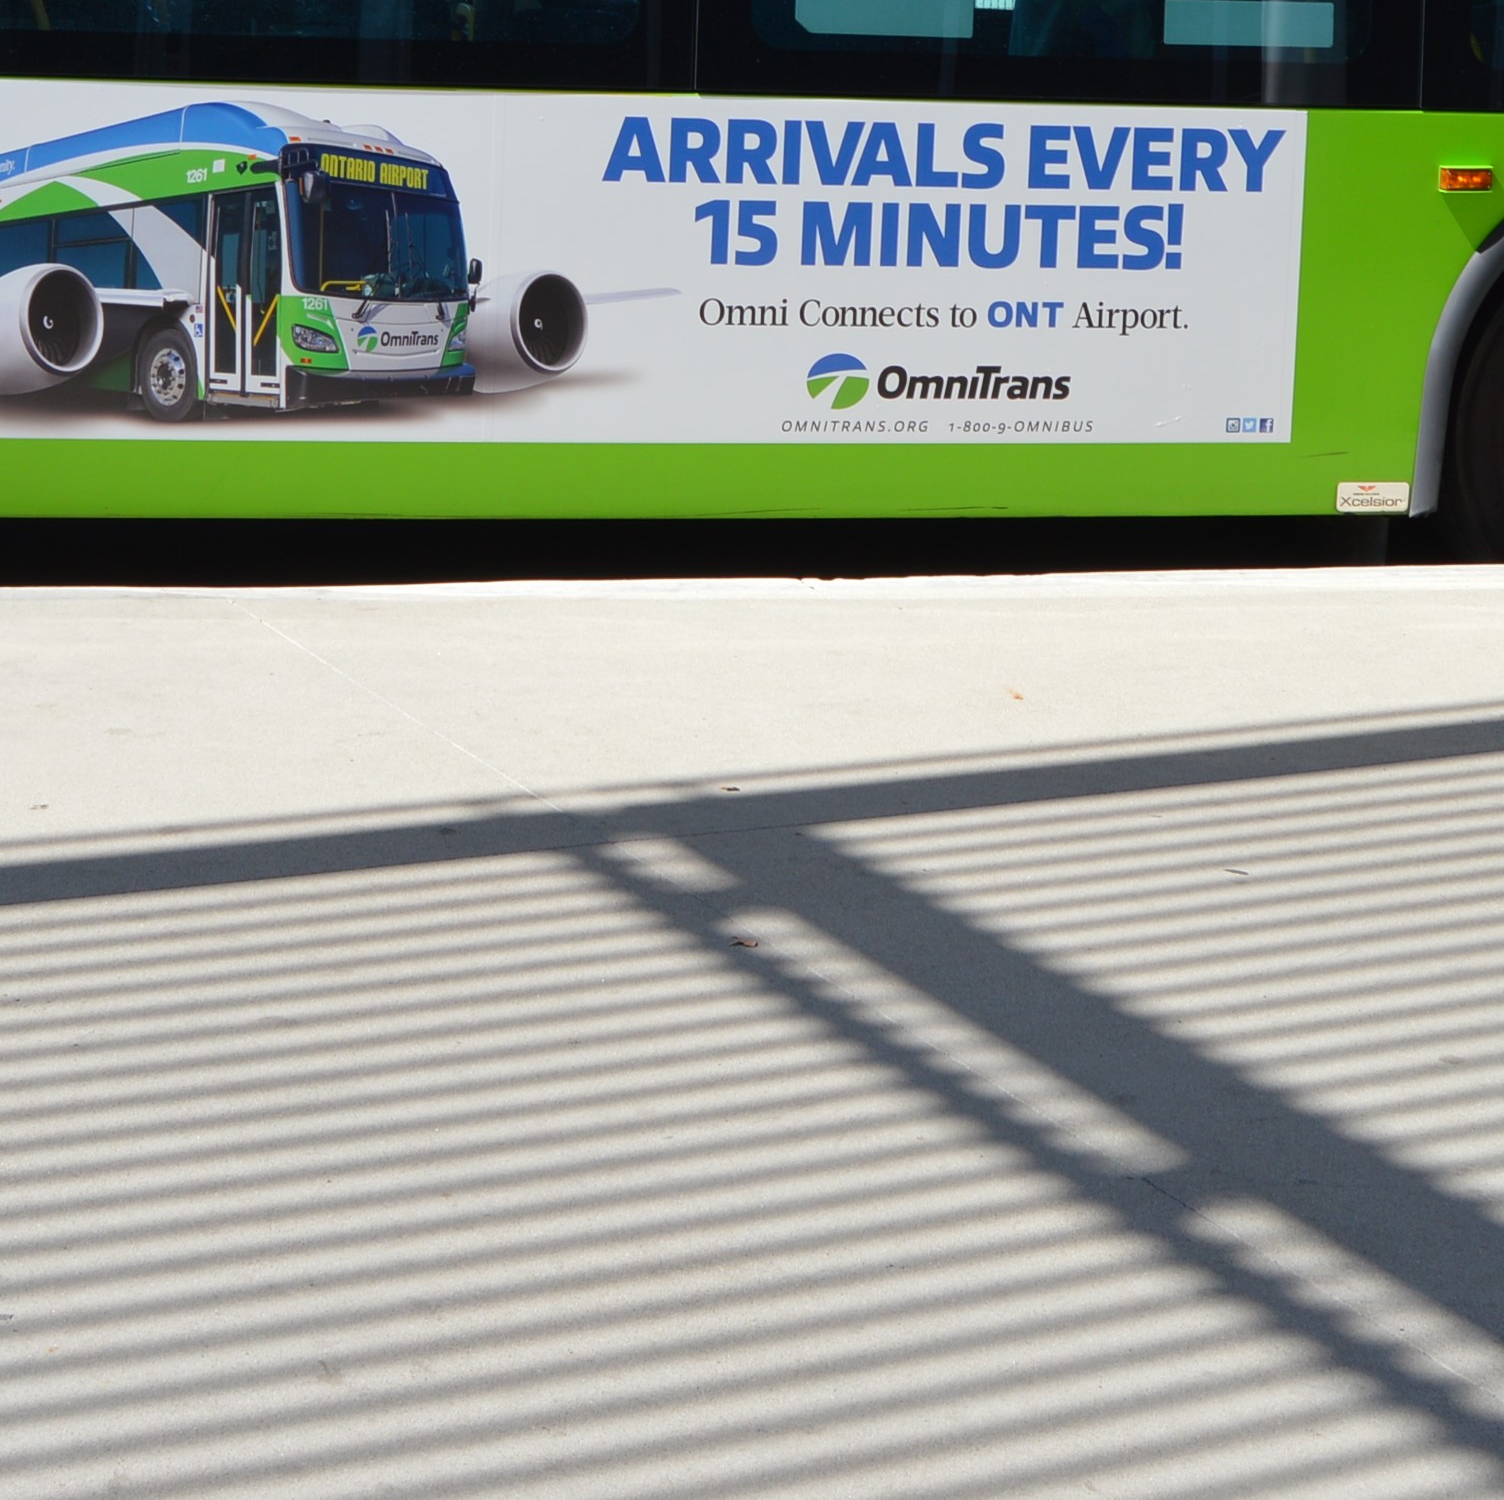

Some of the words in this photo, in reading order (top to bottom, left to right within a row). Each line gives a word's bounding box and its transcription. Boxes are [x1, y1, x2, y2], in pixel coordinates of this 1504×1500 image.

[601, 116, 1005, 189] ARRIVALS
[1026, 125, 1287, 193] EVERY
[186, 168, 208, 184] 1261
[321, 153, 376, 183] ONTARIO
[380, 159, 429, 190] AIRPORT
[694, 199, 778, 267] 15
[799, 201, 1184, 270] MINUTES!
[302, 298, 328, 310] 1261
[699, 298, 789, 326] Omni
[799, 299, 940, 328] Connects
[950, 305, 978, 328] to
[987, 301, 1064, 329] ONT
[1072, 301, 1190, 336] Airport.
[380, 331, 439, 347] OmniTrans
[877, 365, 1071, 400] OmniTrans
[781, 420, 929, 433] OMNITRANS.ORG
[948, 420, 1094, 434] 1-800-9-OMNIBUS
[1339, 495, 1402, 507] Xcelsior
